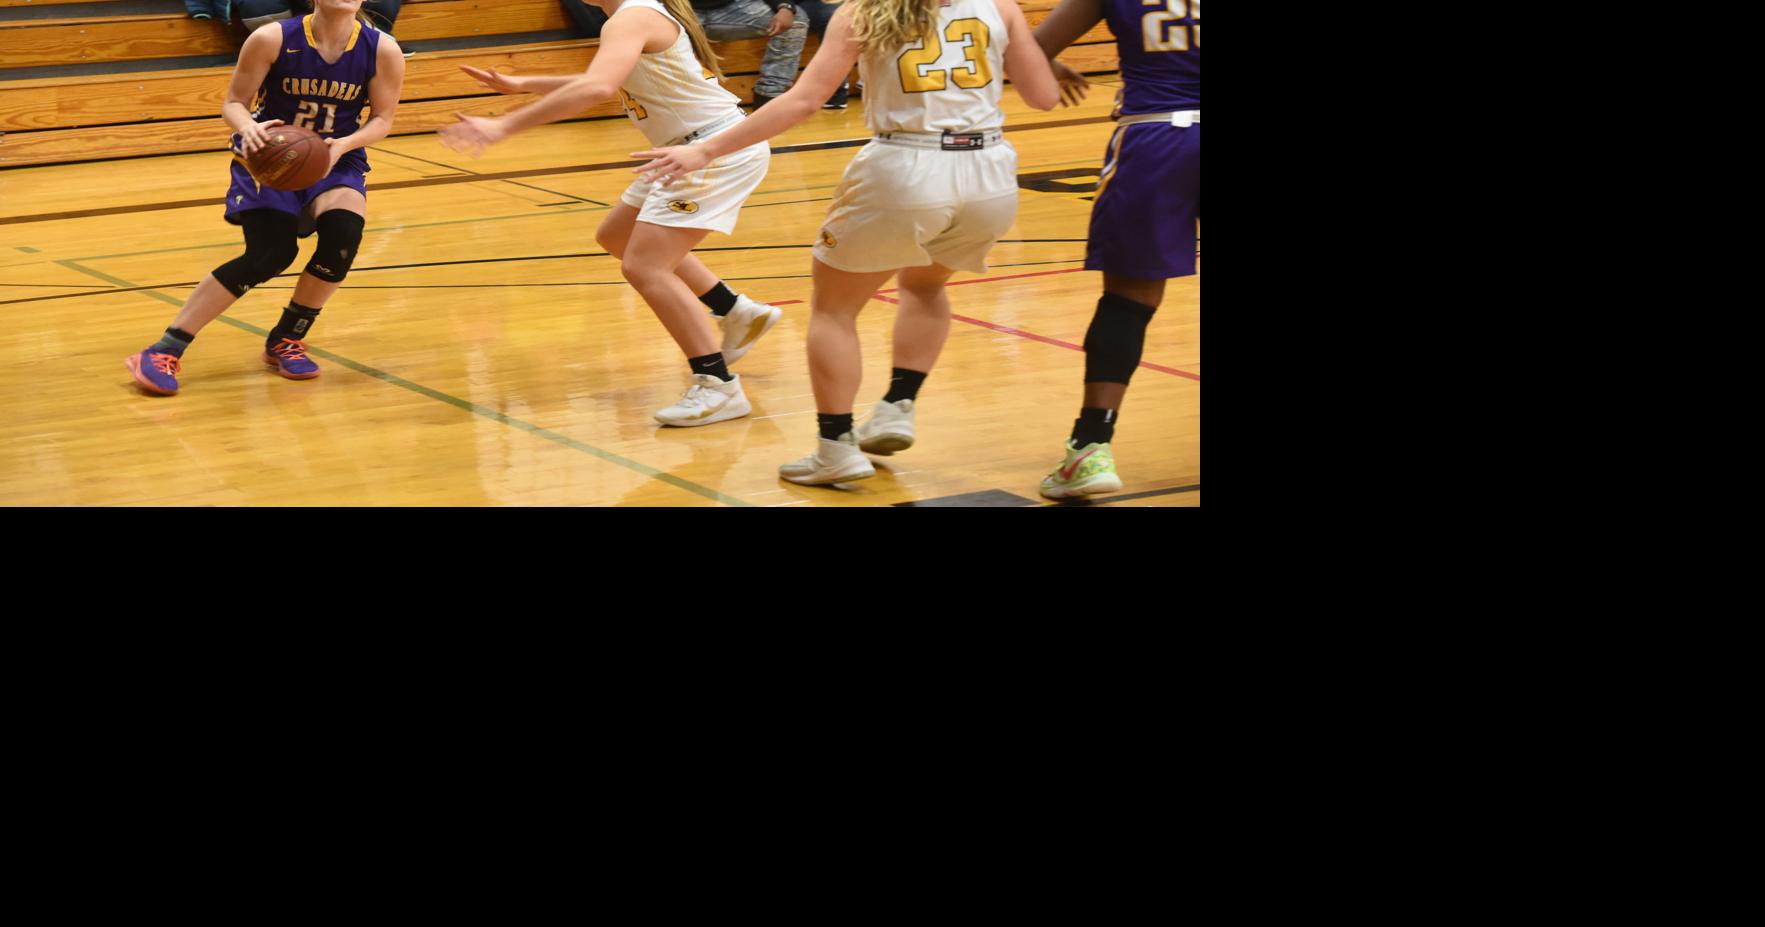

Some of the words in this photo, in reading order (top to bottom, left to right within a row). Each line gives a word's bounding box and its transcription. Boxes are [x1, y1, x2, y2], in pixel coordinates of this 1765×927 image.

[1142, 0, 1200, 52] 2
[897, 17, 993, 93] 23
[282, 77, 362, 101] CRUSADERS
[293, 100, 338, 133] 21
